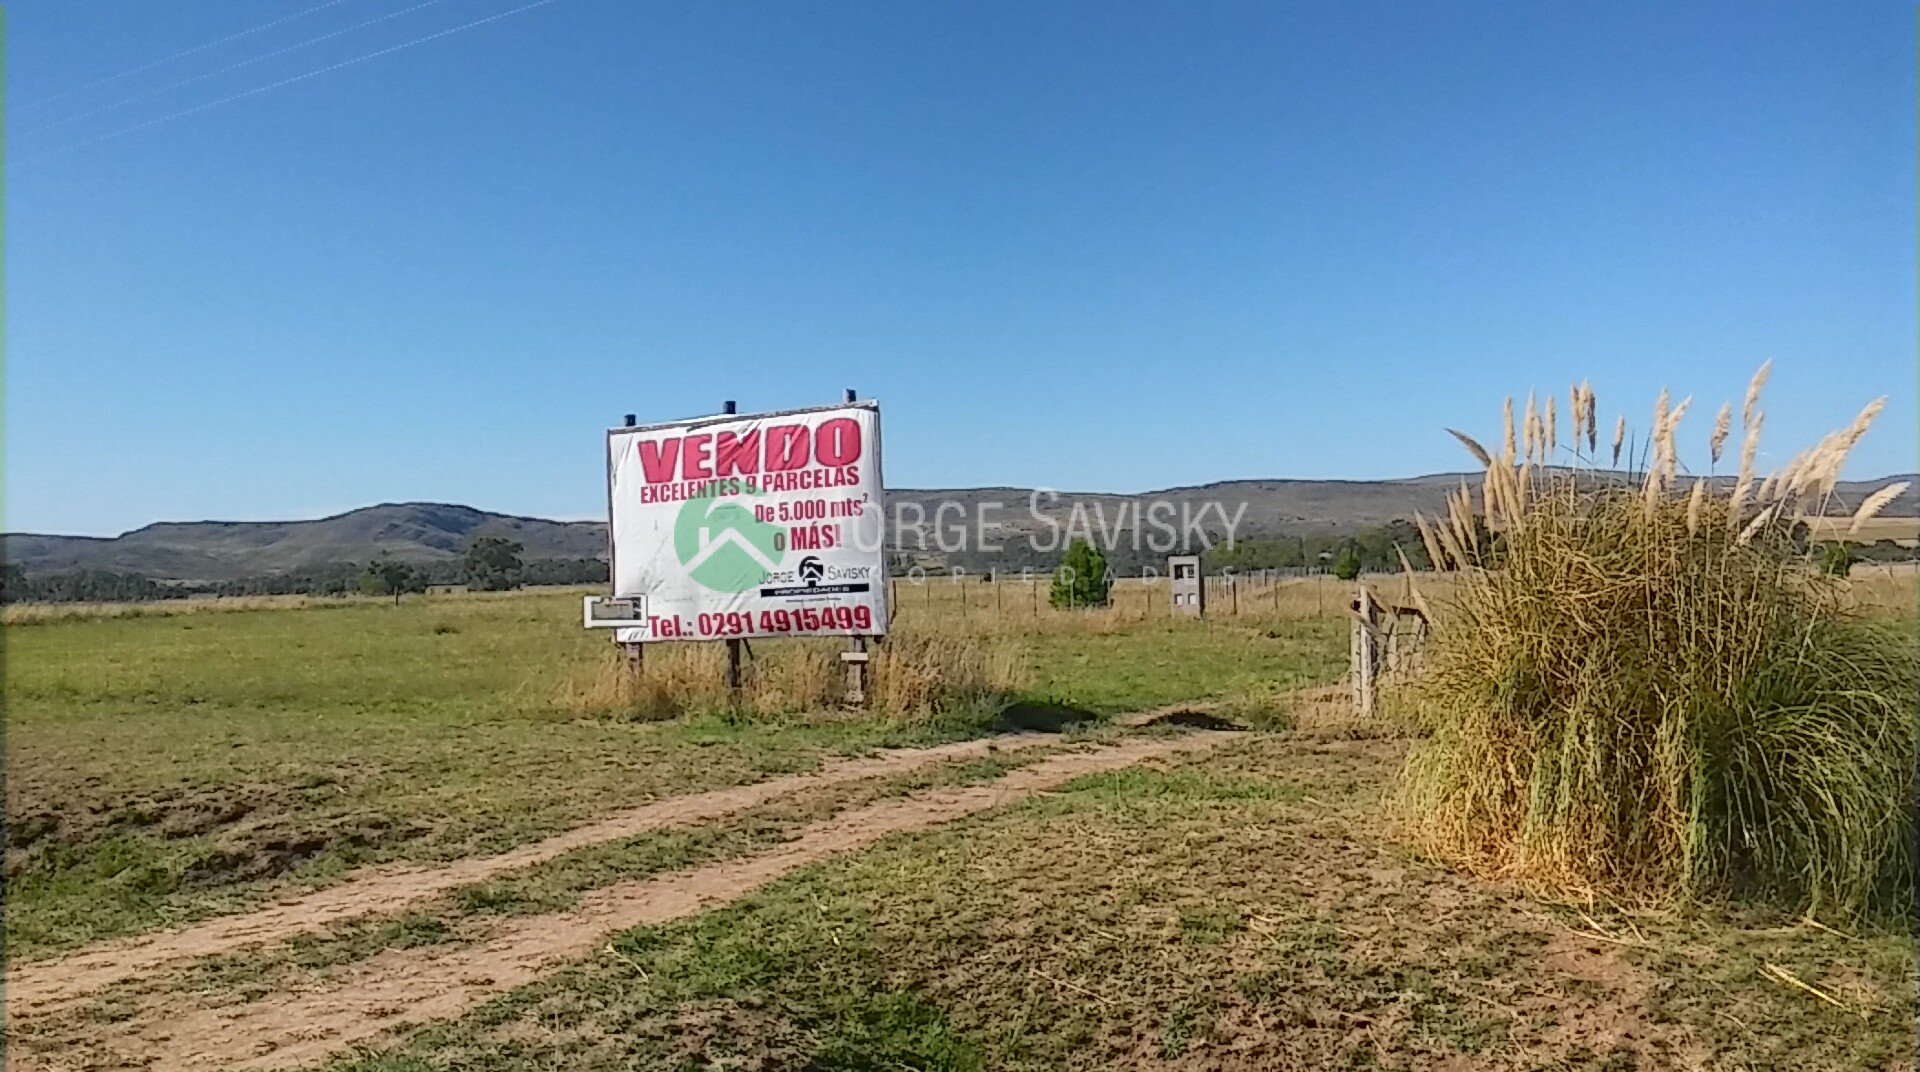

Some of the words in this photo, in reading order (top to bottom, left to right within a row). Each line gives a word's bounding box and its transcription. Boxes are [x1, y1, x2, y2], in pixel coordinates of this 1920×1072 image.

[638, 417, 862, 483] VENDO
[640, 477, 740, 504] EXCELENTES
[745, 476, 757, 494] 9
[762, 466, 859, 492] PARCELAS
[755, 504, 775, 523] De
[778, 500, 826, 521] 5.000
[791, 522, 842, 551] MÁS!
[759, 570, 795, 585] JORGE
[828, 564, 871, 581] SAVISKY
[648, 614, 694, 638] Tel.:
[698, 611, 754, 636] 0291
[759, 605, 872, 633] 4915499
